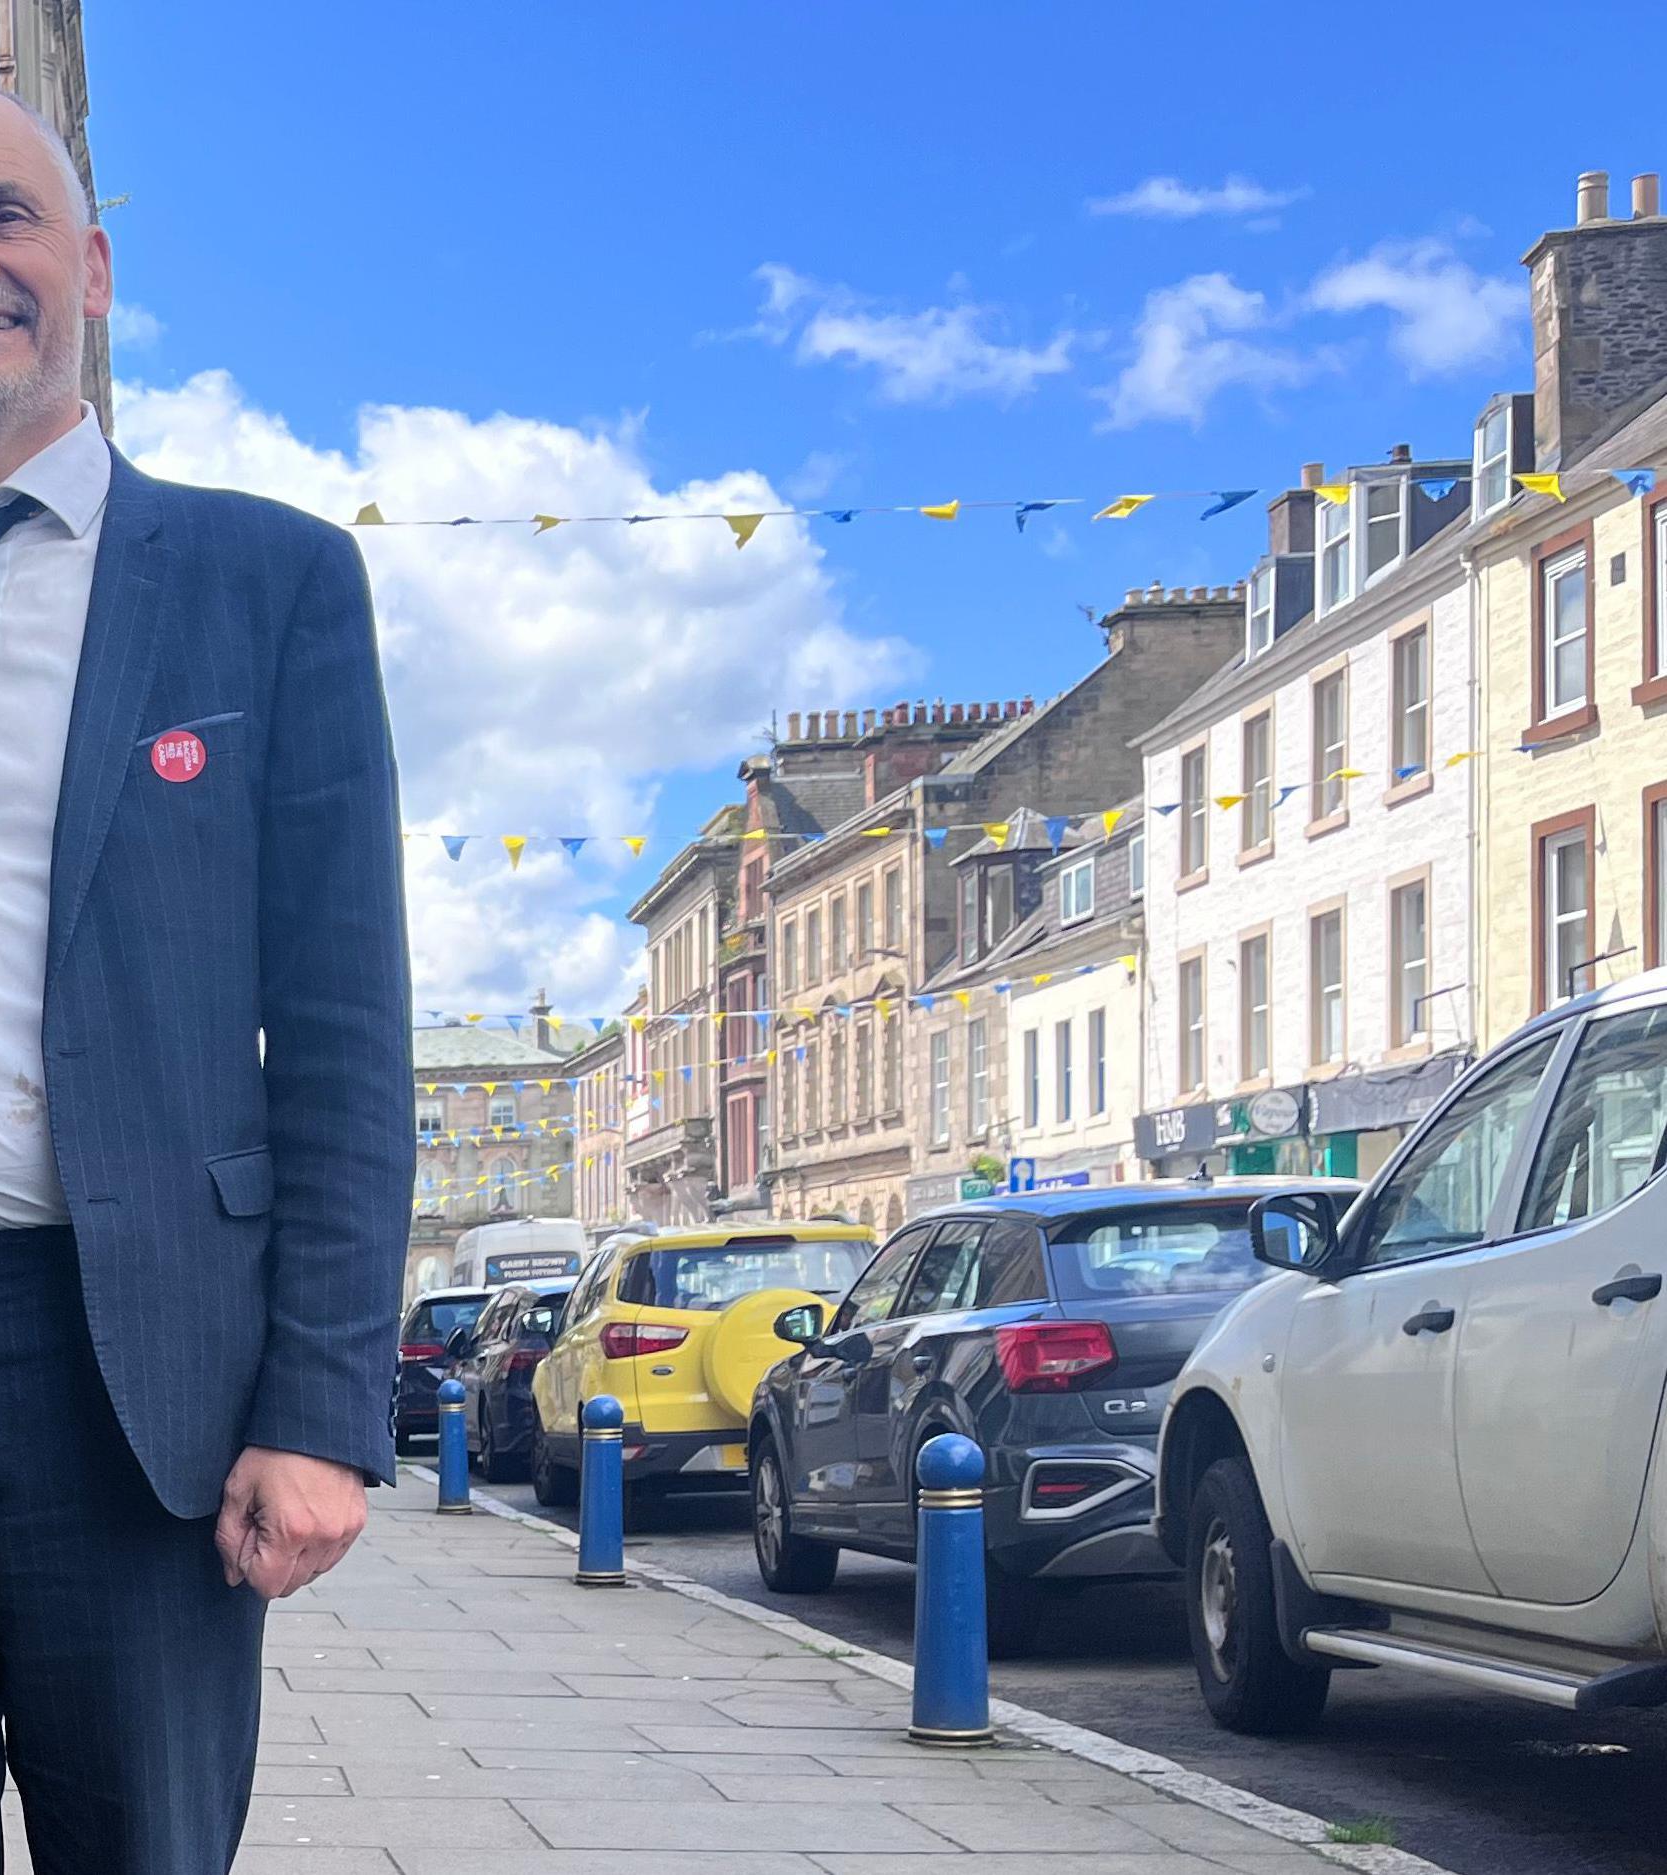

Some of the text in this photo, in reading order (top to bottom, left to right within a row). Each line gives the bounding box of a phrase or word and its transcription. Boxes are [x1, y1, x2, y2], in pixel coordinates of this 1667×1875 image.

[531, 1257, 567, 1267] BROWN
[503, 1268, 563, 1278] FLOOR FITTING
[1104, 1400, 1148, 1415] Q2
